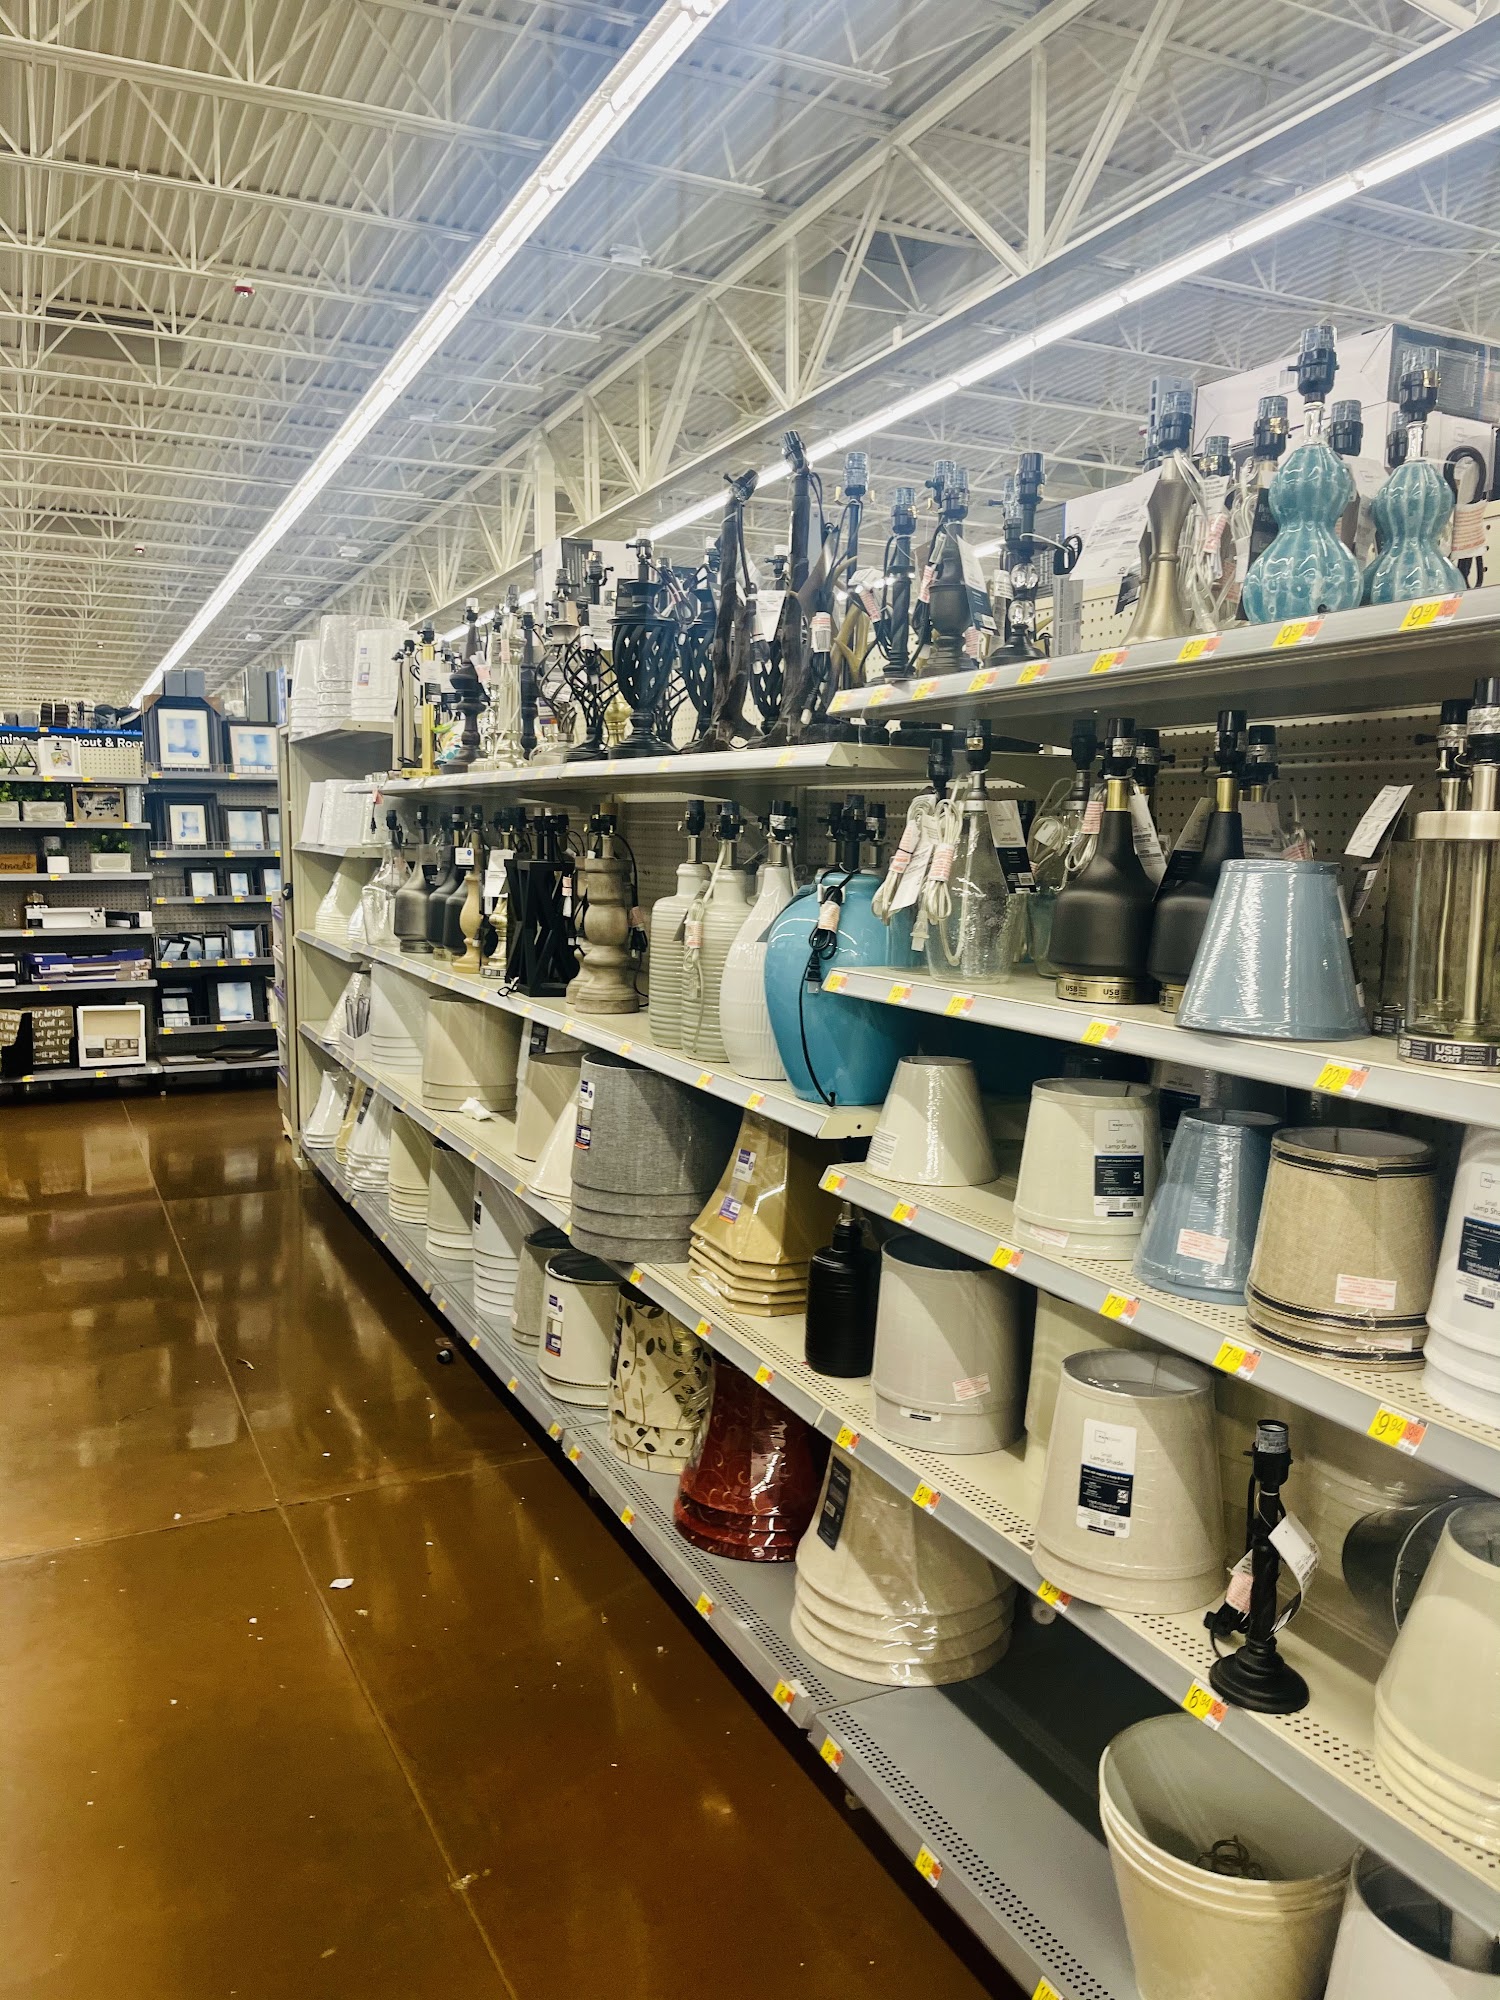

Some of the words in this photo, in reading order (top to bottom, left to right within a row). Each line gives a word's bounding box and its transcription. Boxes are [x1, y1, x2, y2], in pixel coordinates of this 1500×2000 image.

[105, 737, 114, 747] &
[1065, 985, 1078, 993] USB
[1103, 988, 1120, 996] USB
[1435, 1044, 1462, 1056] USB
[1434, 1054, 1462, 1064] PORT
[1473, 1203, 1489, 1213] Lamp
[1106, 1458, 1124, 1466] Shade
